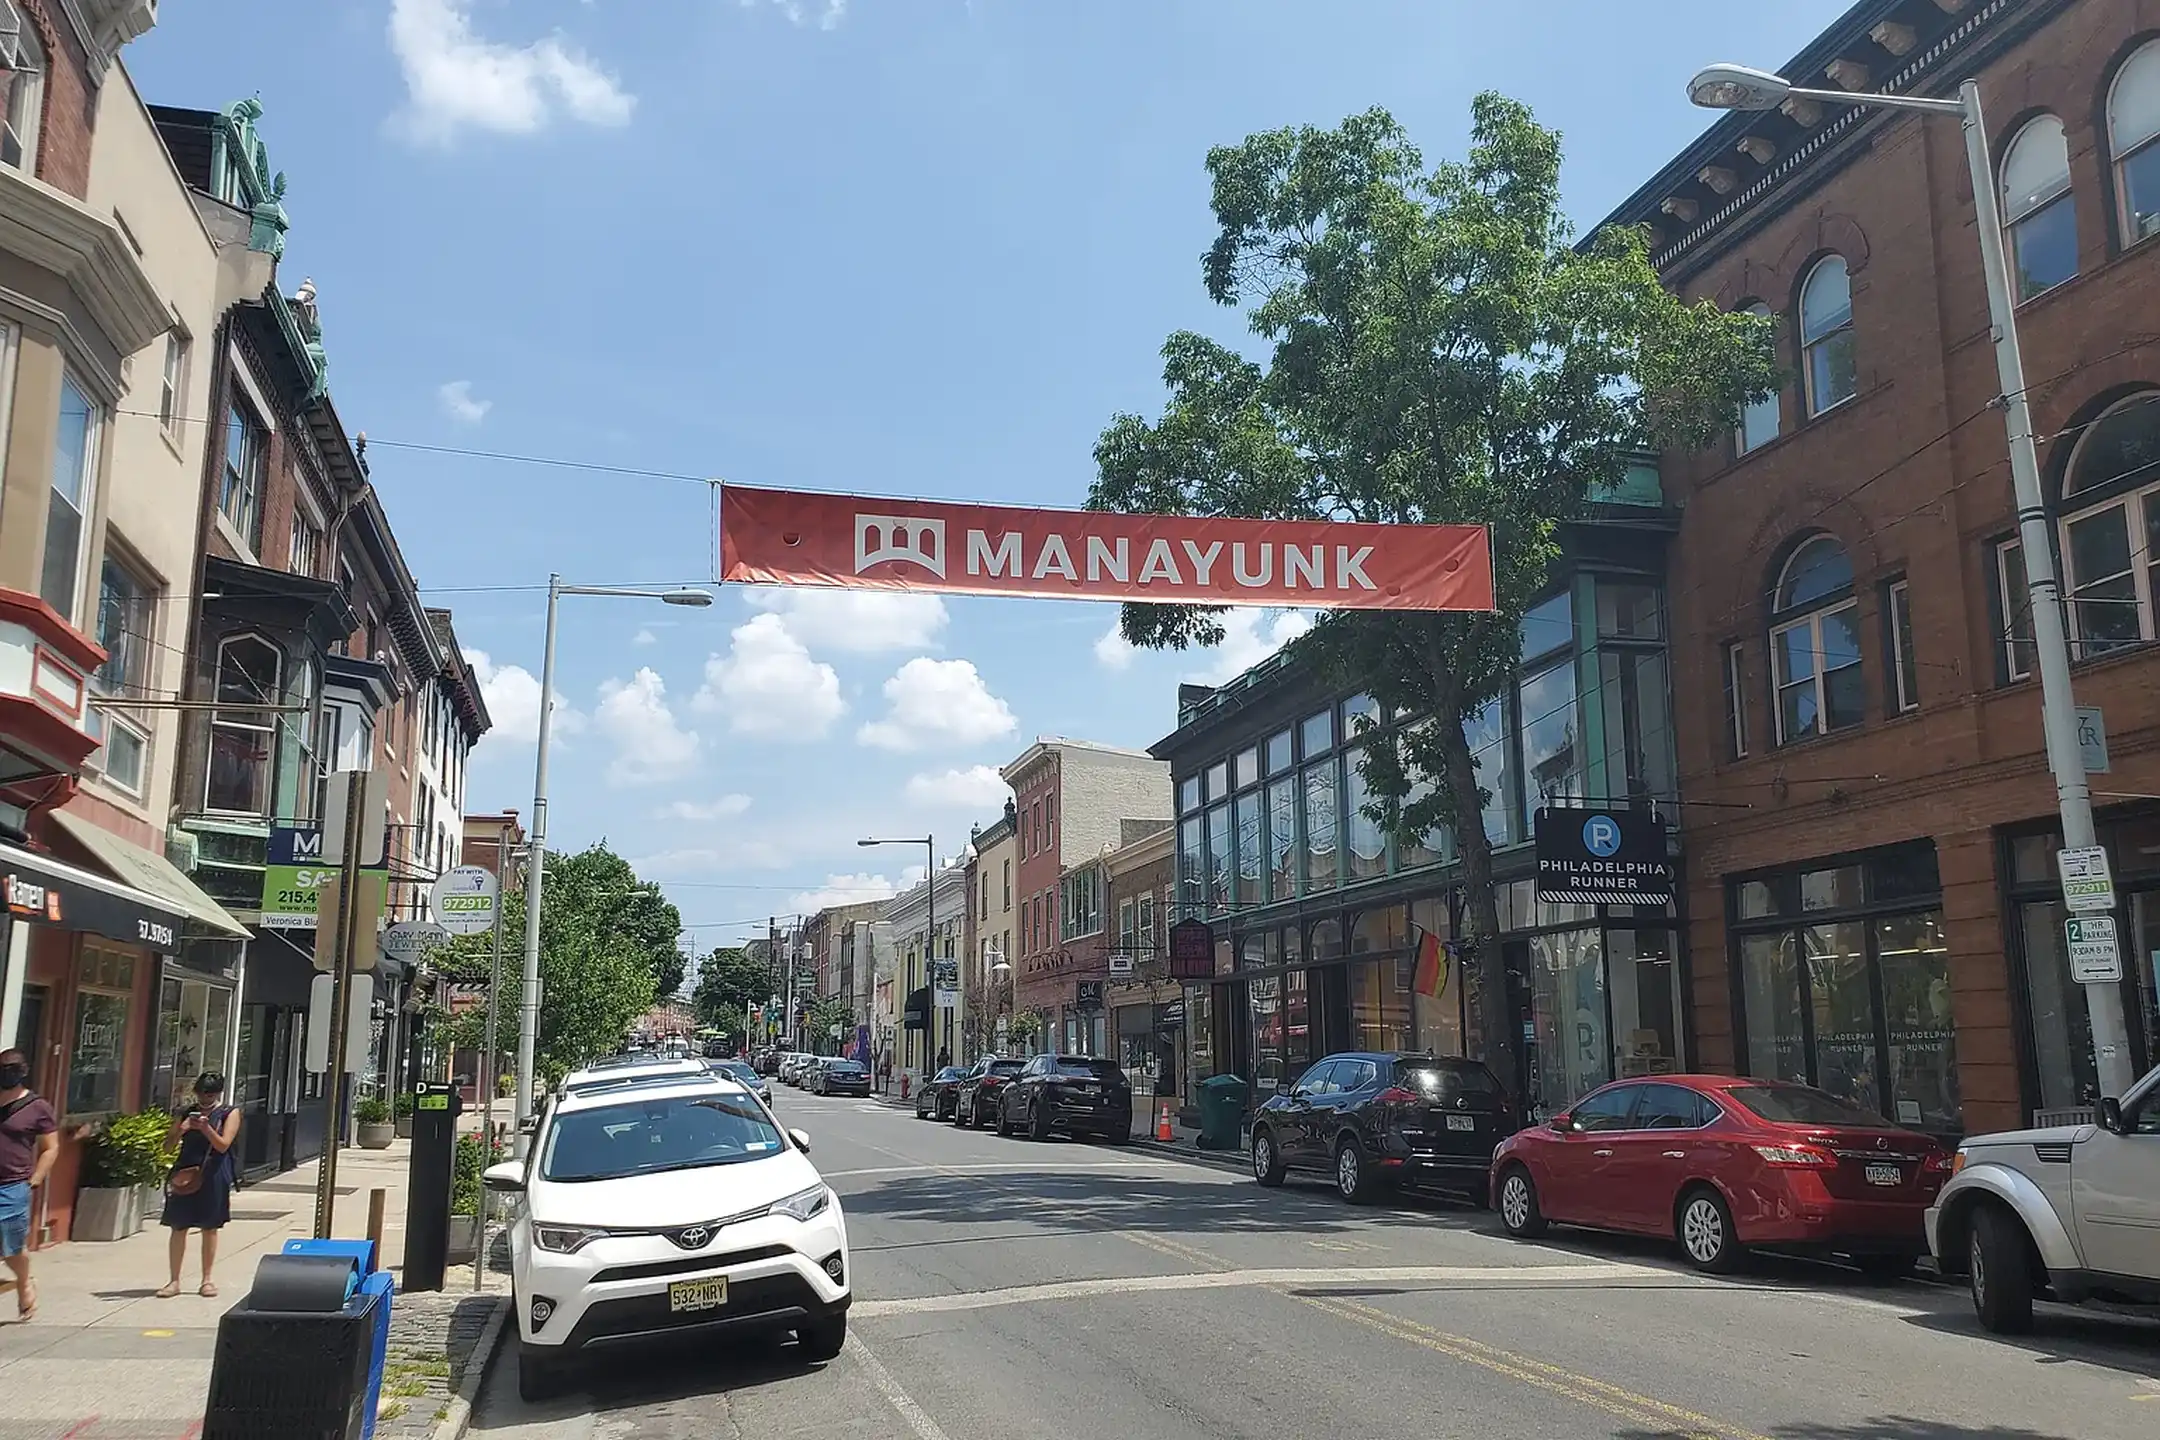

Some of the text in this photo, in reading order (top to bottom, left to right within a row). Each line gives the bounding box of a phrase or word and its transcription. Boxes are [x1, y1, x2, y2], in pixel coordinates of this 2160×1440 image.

[966, 529, 1378, 590] MANAYUNK
[1592, 823, 1613, 848] R
[1540, 860, 1665, 875] PHILADELPHIA
[1571, 876, 1638, 889] RUNNER
[2066, 882, 2109, 896] 972911
[278, 890, 320, 904] 215.4
[443, 898, 492, 909] 972912
[278, 904, 318, 914] www.mp
[265, 915, 302, 926] Veronica
[2070, 924, 2080, 939] 2
[2083, 930, 2113, 939] PARKING
[1817, 1033, 1875, 1041] PHILADELPHIA
[1890, 1031, 1955, 1039] PHILADELPHIA
[416, 1082, 427, 1094] D
